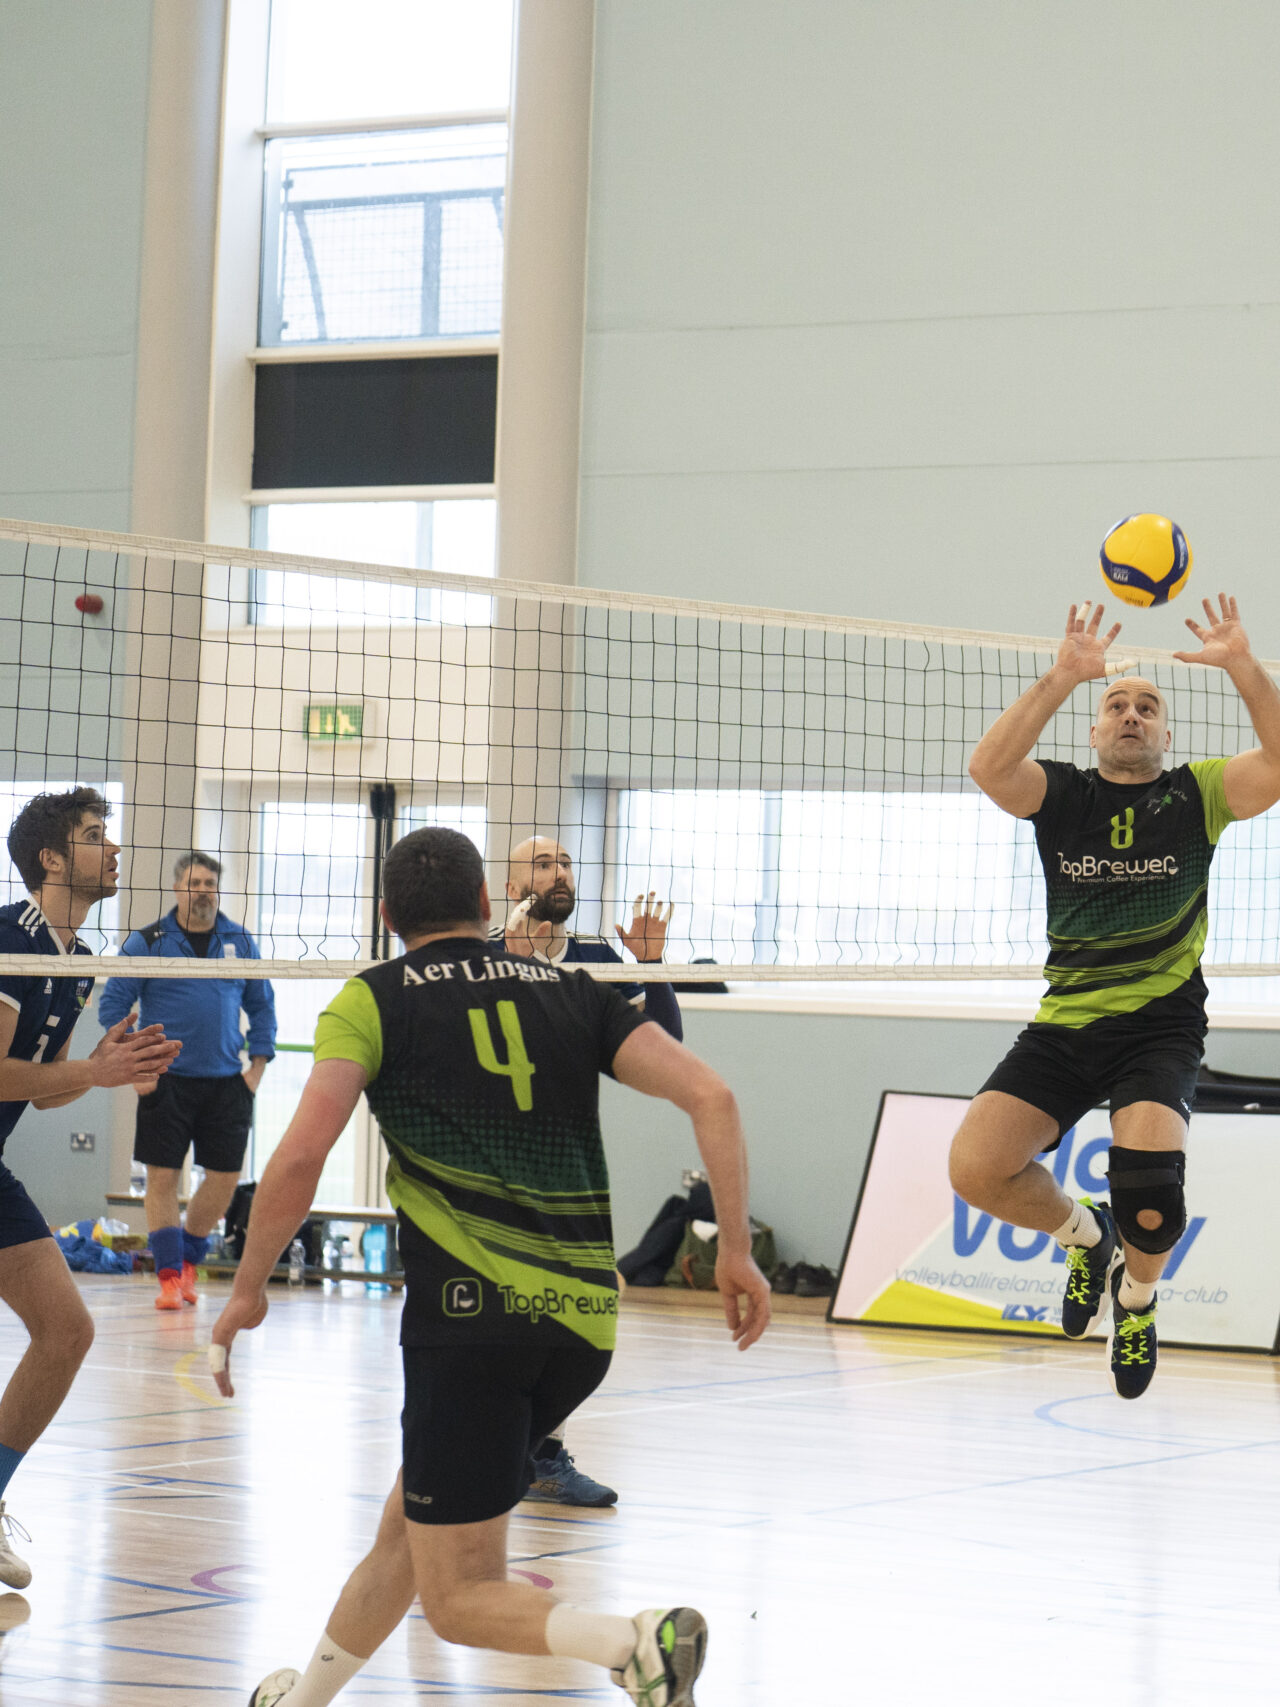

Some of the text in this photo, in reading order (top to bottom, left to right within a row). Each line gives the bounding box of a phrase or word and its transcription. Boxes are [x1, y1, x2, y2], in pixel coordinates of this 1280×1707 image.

[1110, 806, 1135, 850] 8
[1057, 851, 1179, 882] TopBrewer
[403, 956, 561, 986] Aer Lingus
[467, 1000, 536, 1112] 4
